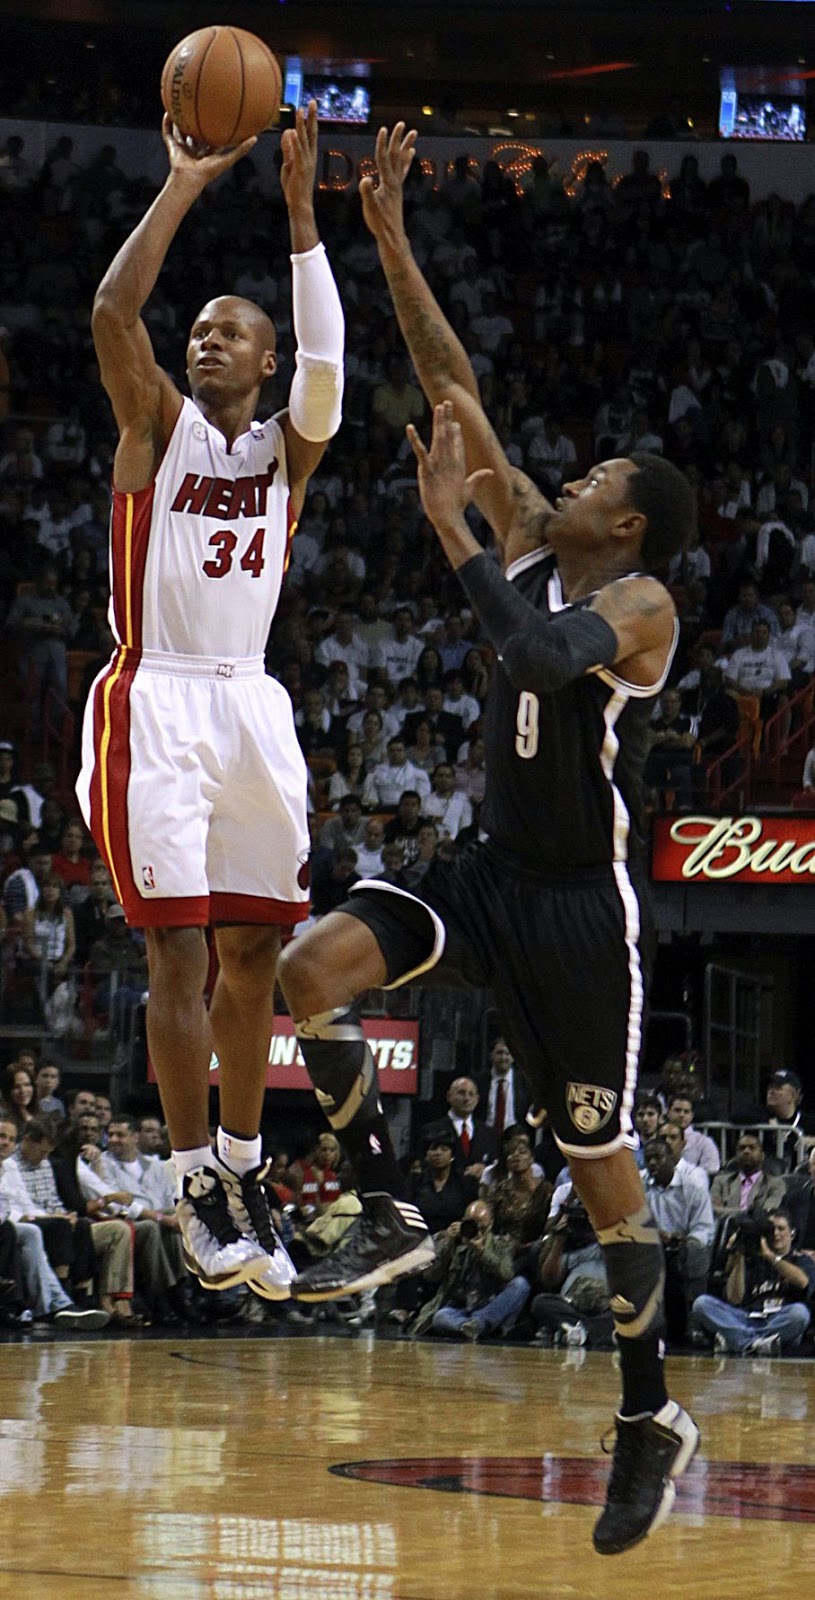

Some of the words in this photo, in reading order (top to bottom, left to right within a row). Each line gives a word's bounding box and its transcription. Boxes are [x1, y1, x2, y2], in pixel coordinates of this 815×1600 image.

[170, 456, 279, 521] HEAT
[202, 528, 266, 579] 34
[515, 690, 540, 759] 9
[567, 1084, 614, 1112] NETS
